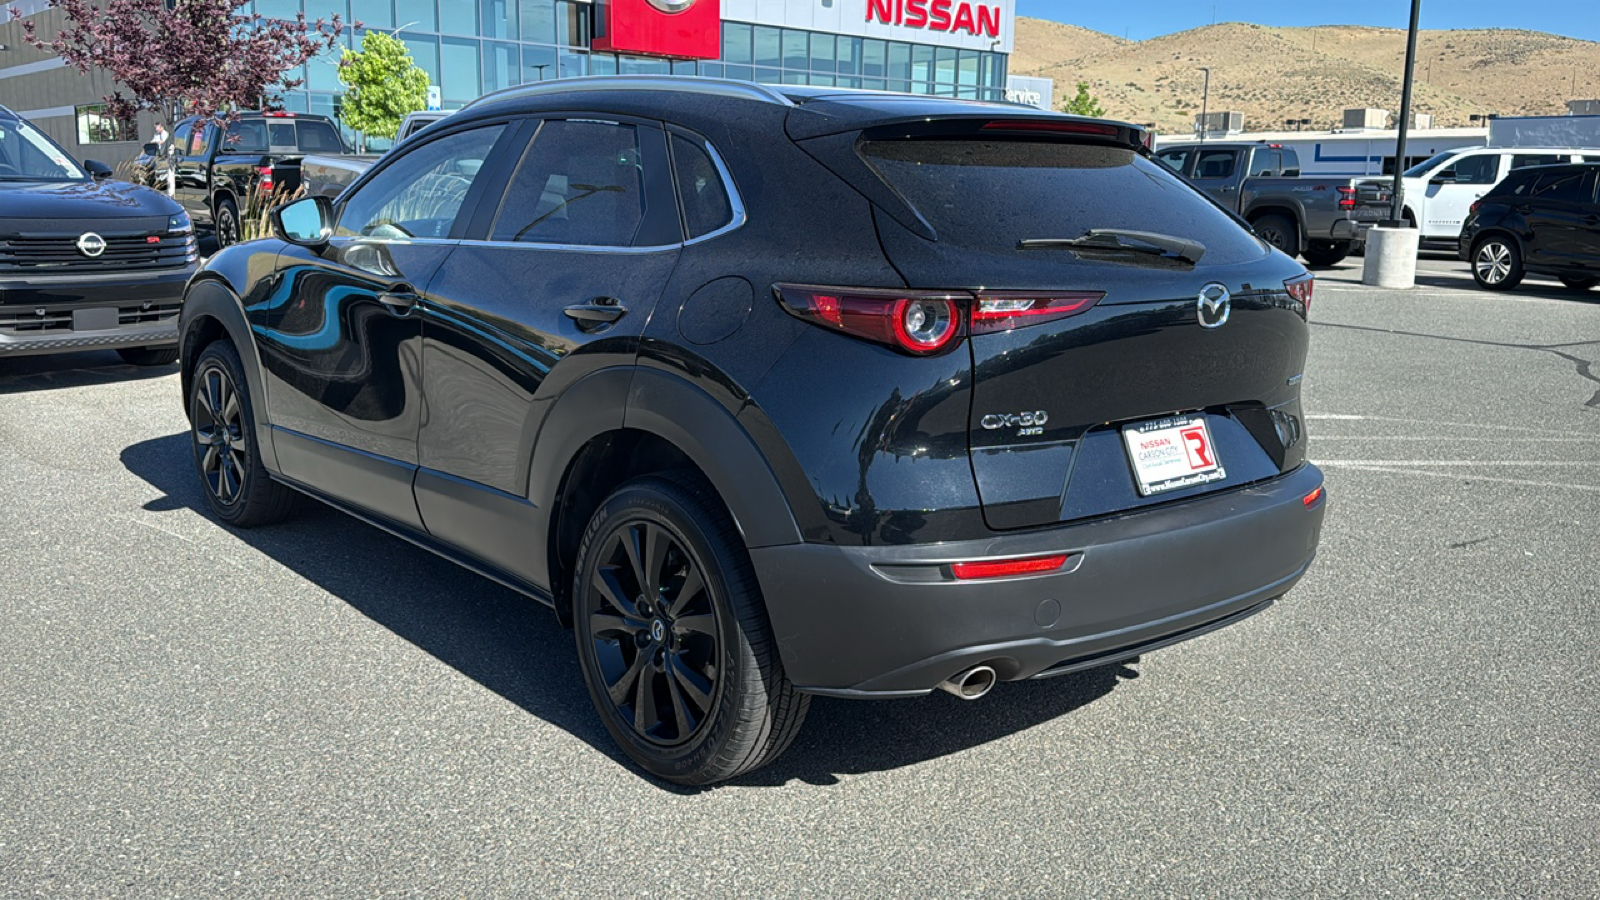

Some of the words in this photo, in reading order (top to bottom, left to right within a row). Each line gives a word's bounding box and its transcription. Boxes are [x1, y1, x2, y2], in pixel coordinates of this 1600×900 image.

[865, 0, 1000, 38] NISSAN
[980, 410, 1048, 430] CX-30
[1140, 438, 1171, 450] NISSAN
